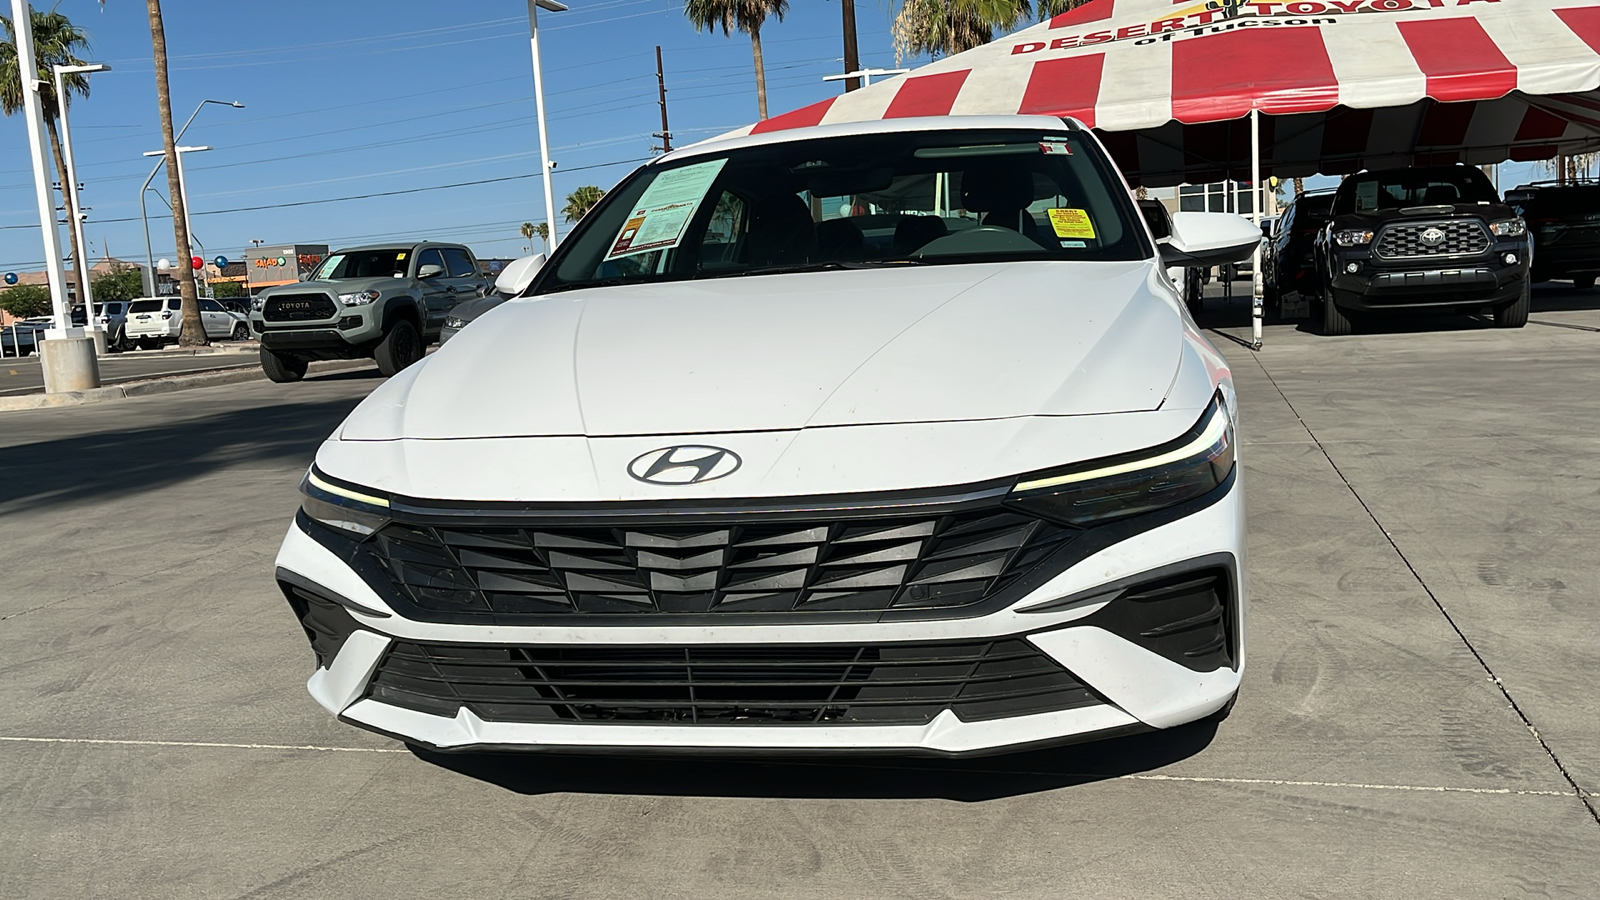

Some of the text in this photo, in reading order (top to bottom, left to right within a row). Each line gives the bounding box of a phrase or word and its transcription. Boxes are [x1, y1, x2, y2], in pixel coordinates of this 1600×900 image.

[1011, 8, 1223, 55] DESERT
[1134, 18, 1337, 46] of Tucson
